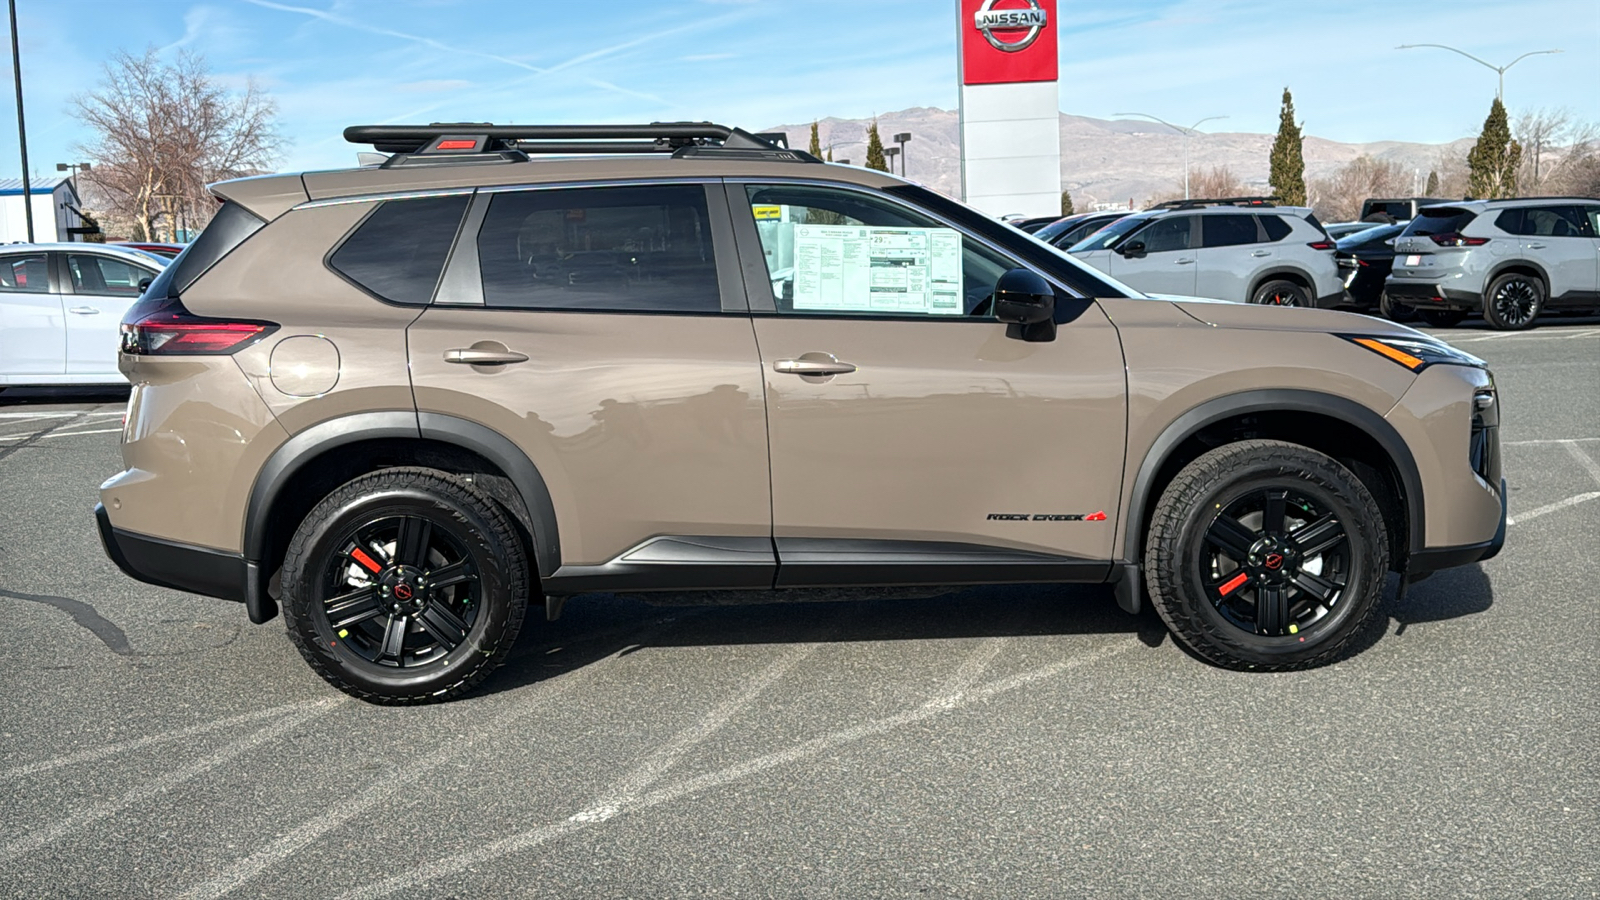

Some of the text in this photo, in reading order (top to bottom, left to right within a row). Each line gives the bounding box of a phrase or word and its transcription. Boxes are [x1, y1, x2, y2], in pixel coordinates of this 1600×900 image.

[983, 12, 1040, 24] NISSAN
[874, 236, 883, 244] 29
[986, 513, 1031, 521] ROCK
